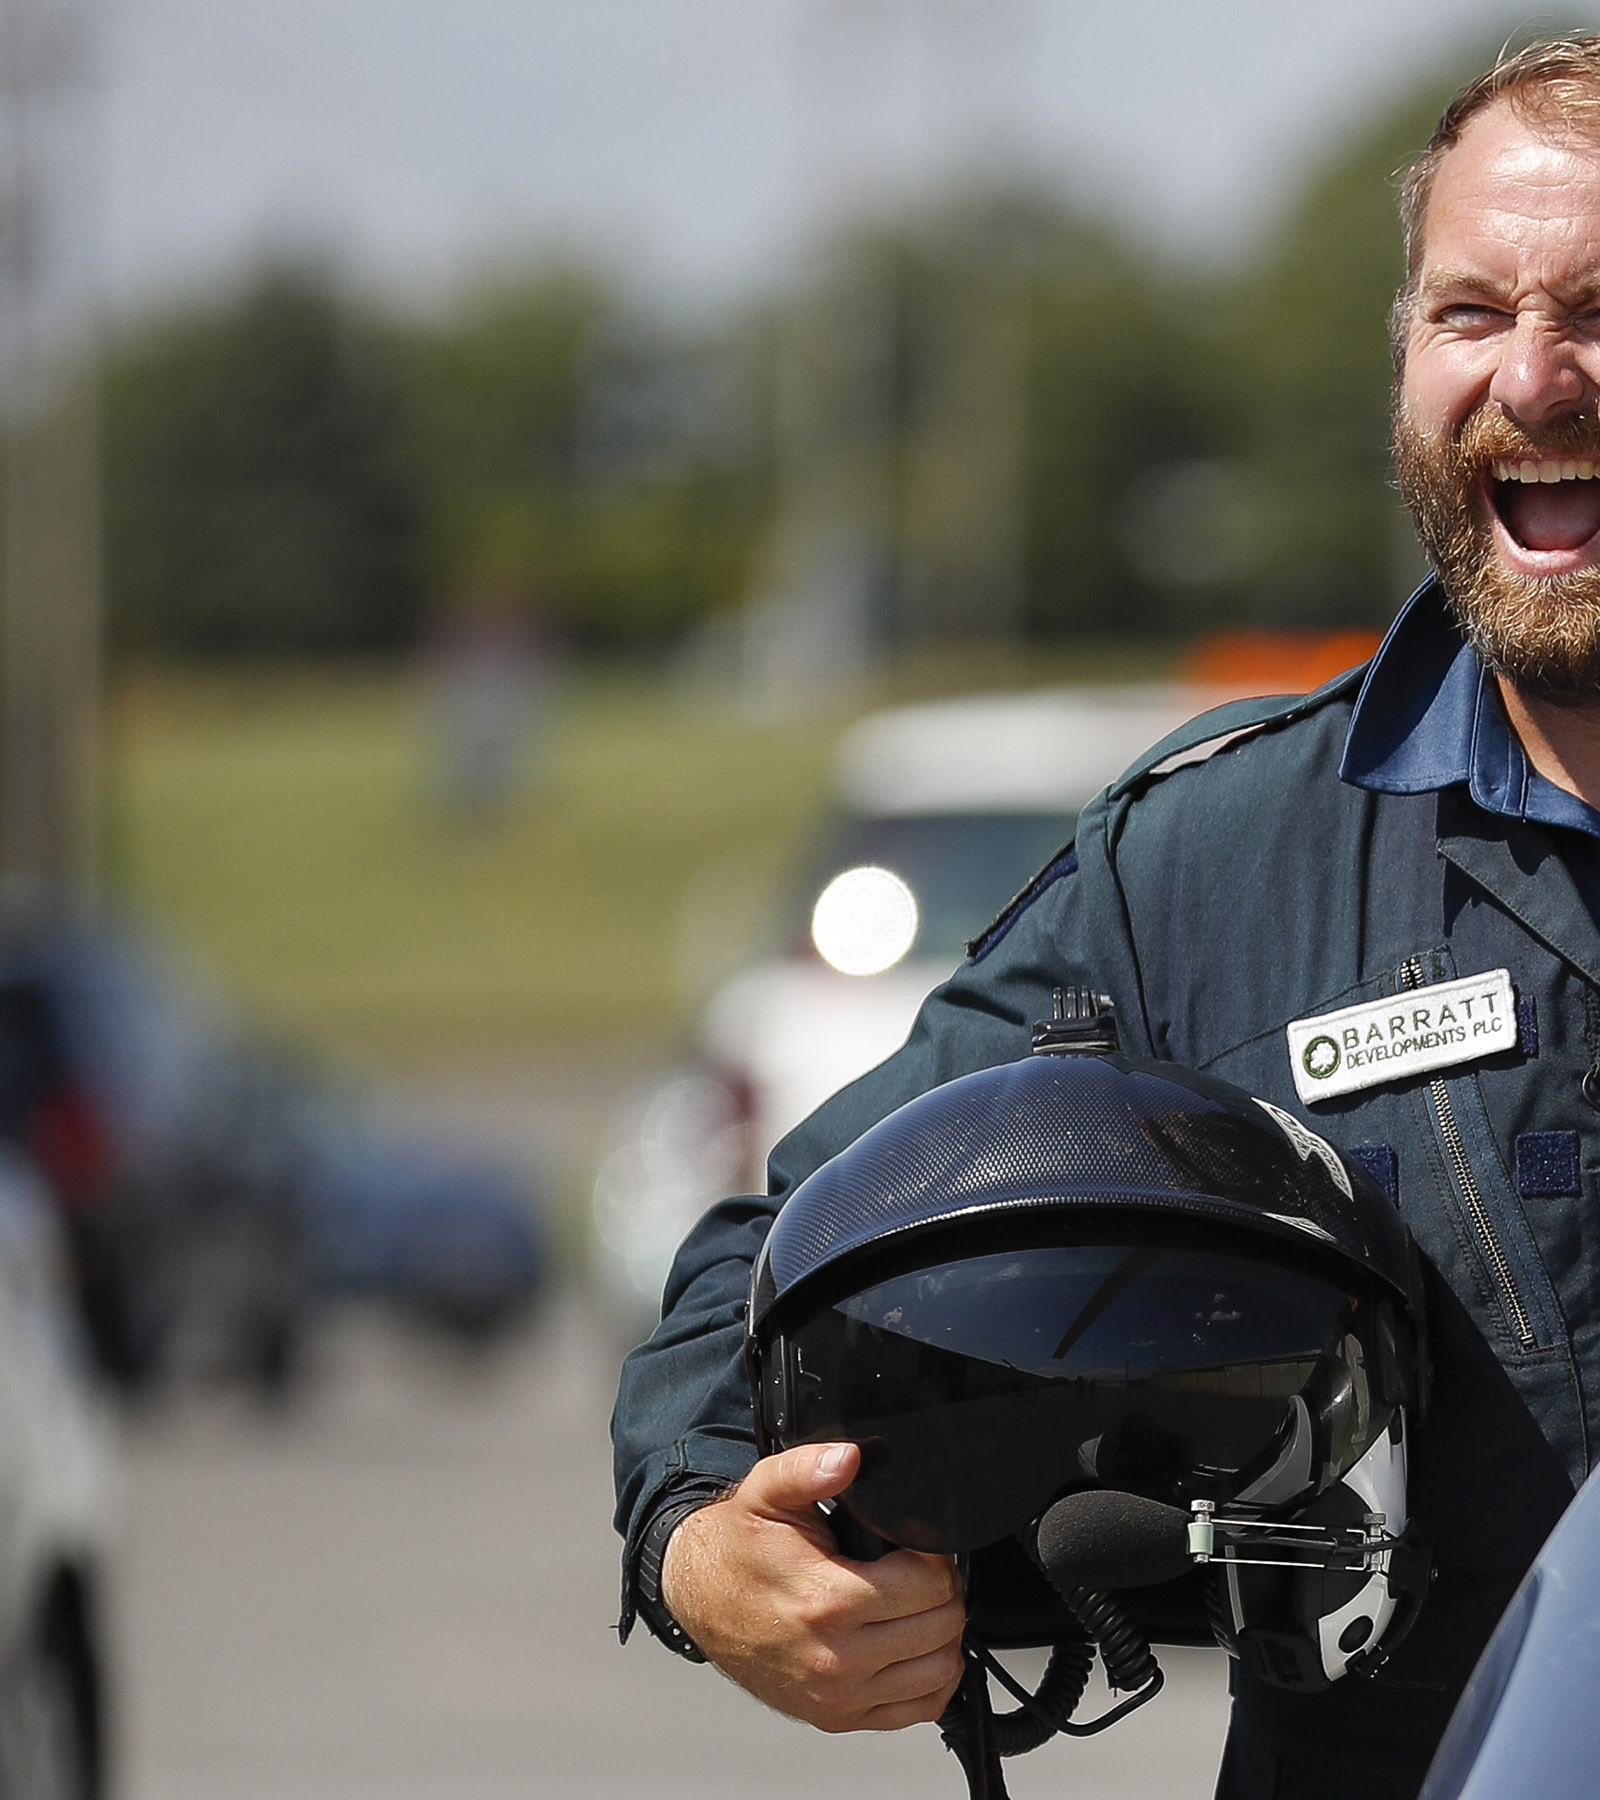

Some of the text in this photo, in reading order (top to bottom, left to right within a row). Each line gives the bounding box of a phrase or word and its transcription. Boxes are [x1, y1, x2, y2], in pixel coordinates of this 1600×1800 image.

[1342, 992, 1498, 1050] BARRATT
[1346, 1017, 1503, 1069] DEVELOPMENTS PLC
